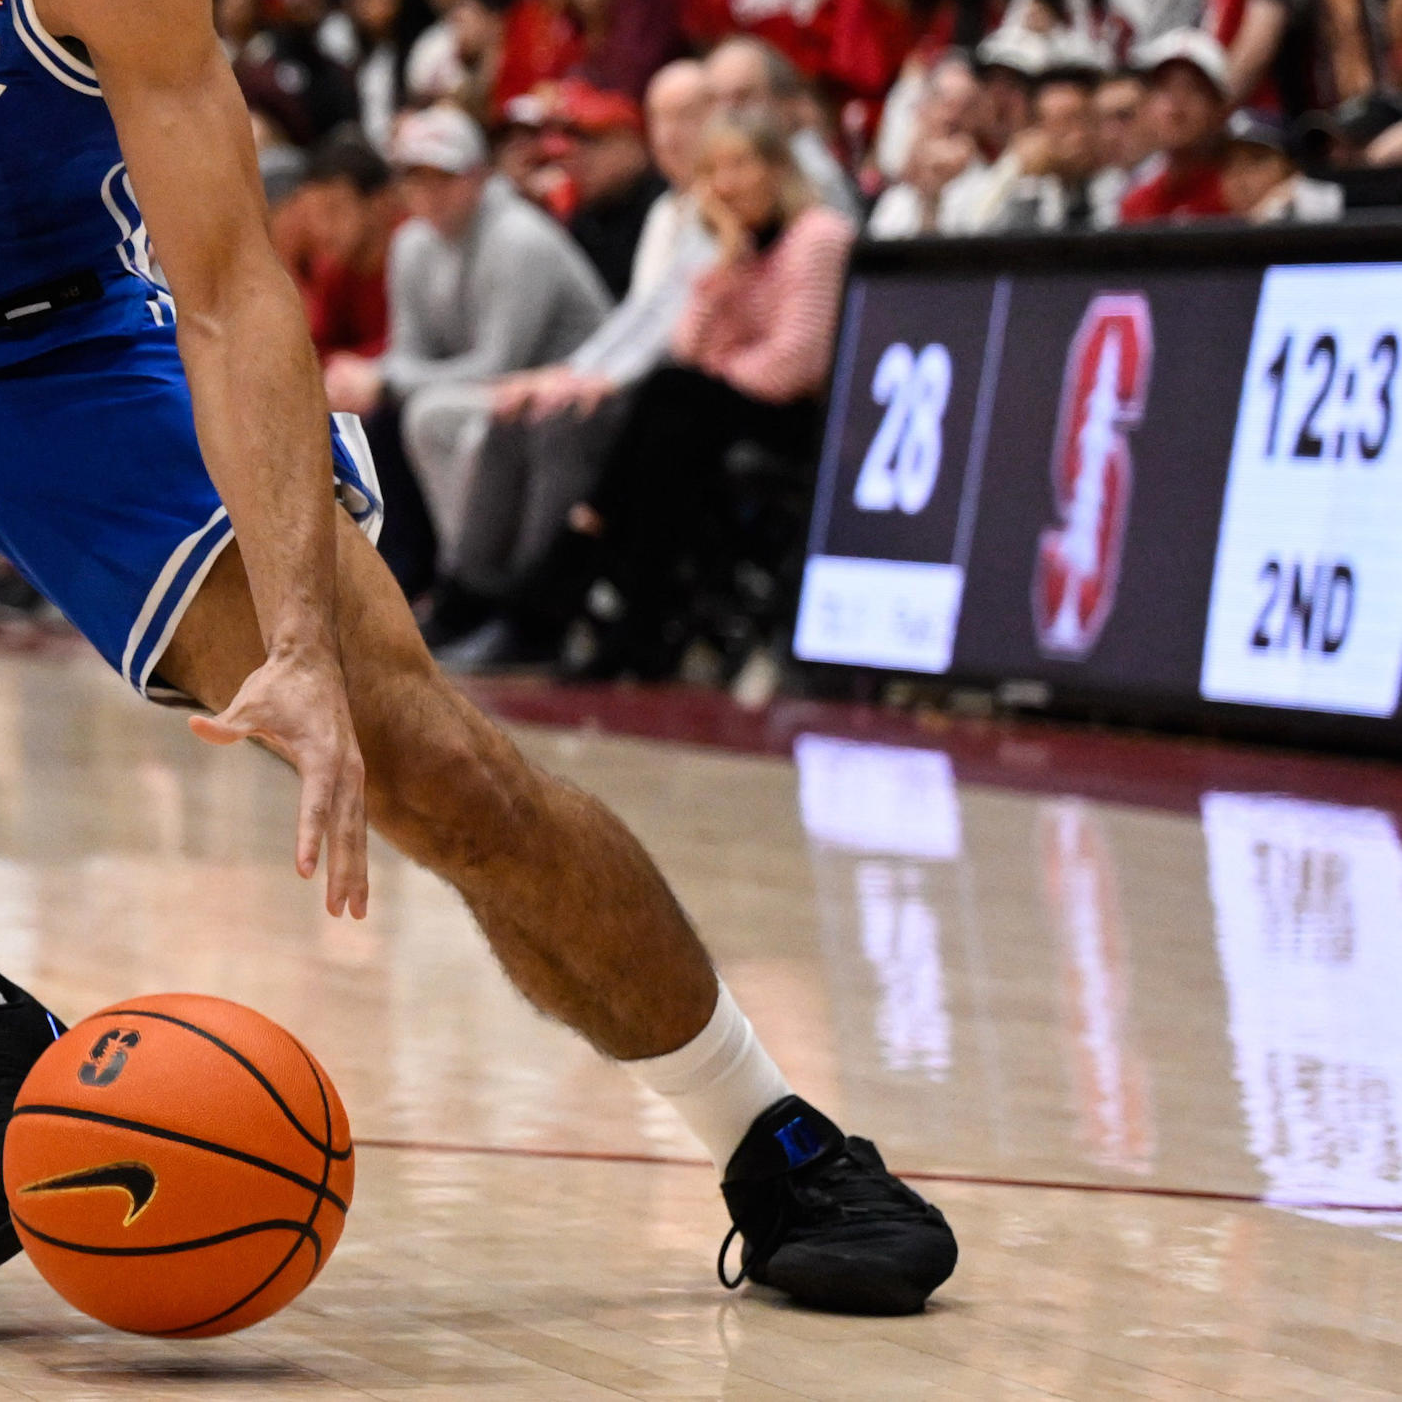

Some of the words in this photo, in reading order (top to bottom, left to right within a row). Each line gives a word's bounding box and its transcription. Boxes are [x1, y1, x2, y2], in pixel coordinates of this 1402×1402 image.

[855, 343, 951, 514] 28
[1264, 332, 1399, 461] 12:3
[1249, 559, 1355, 654] 2ND
